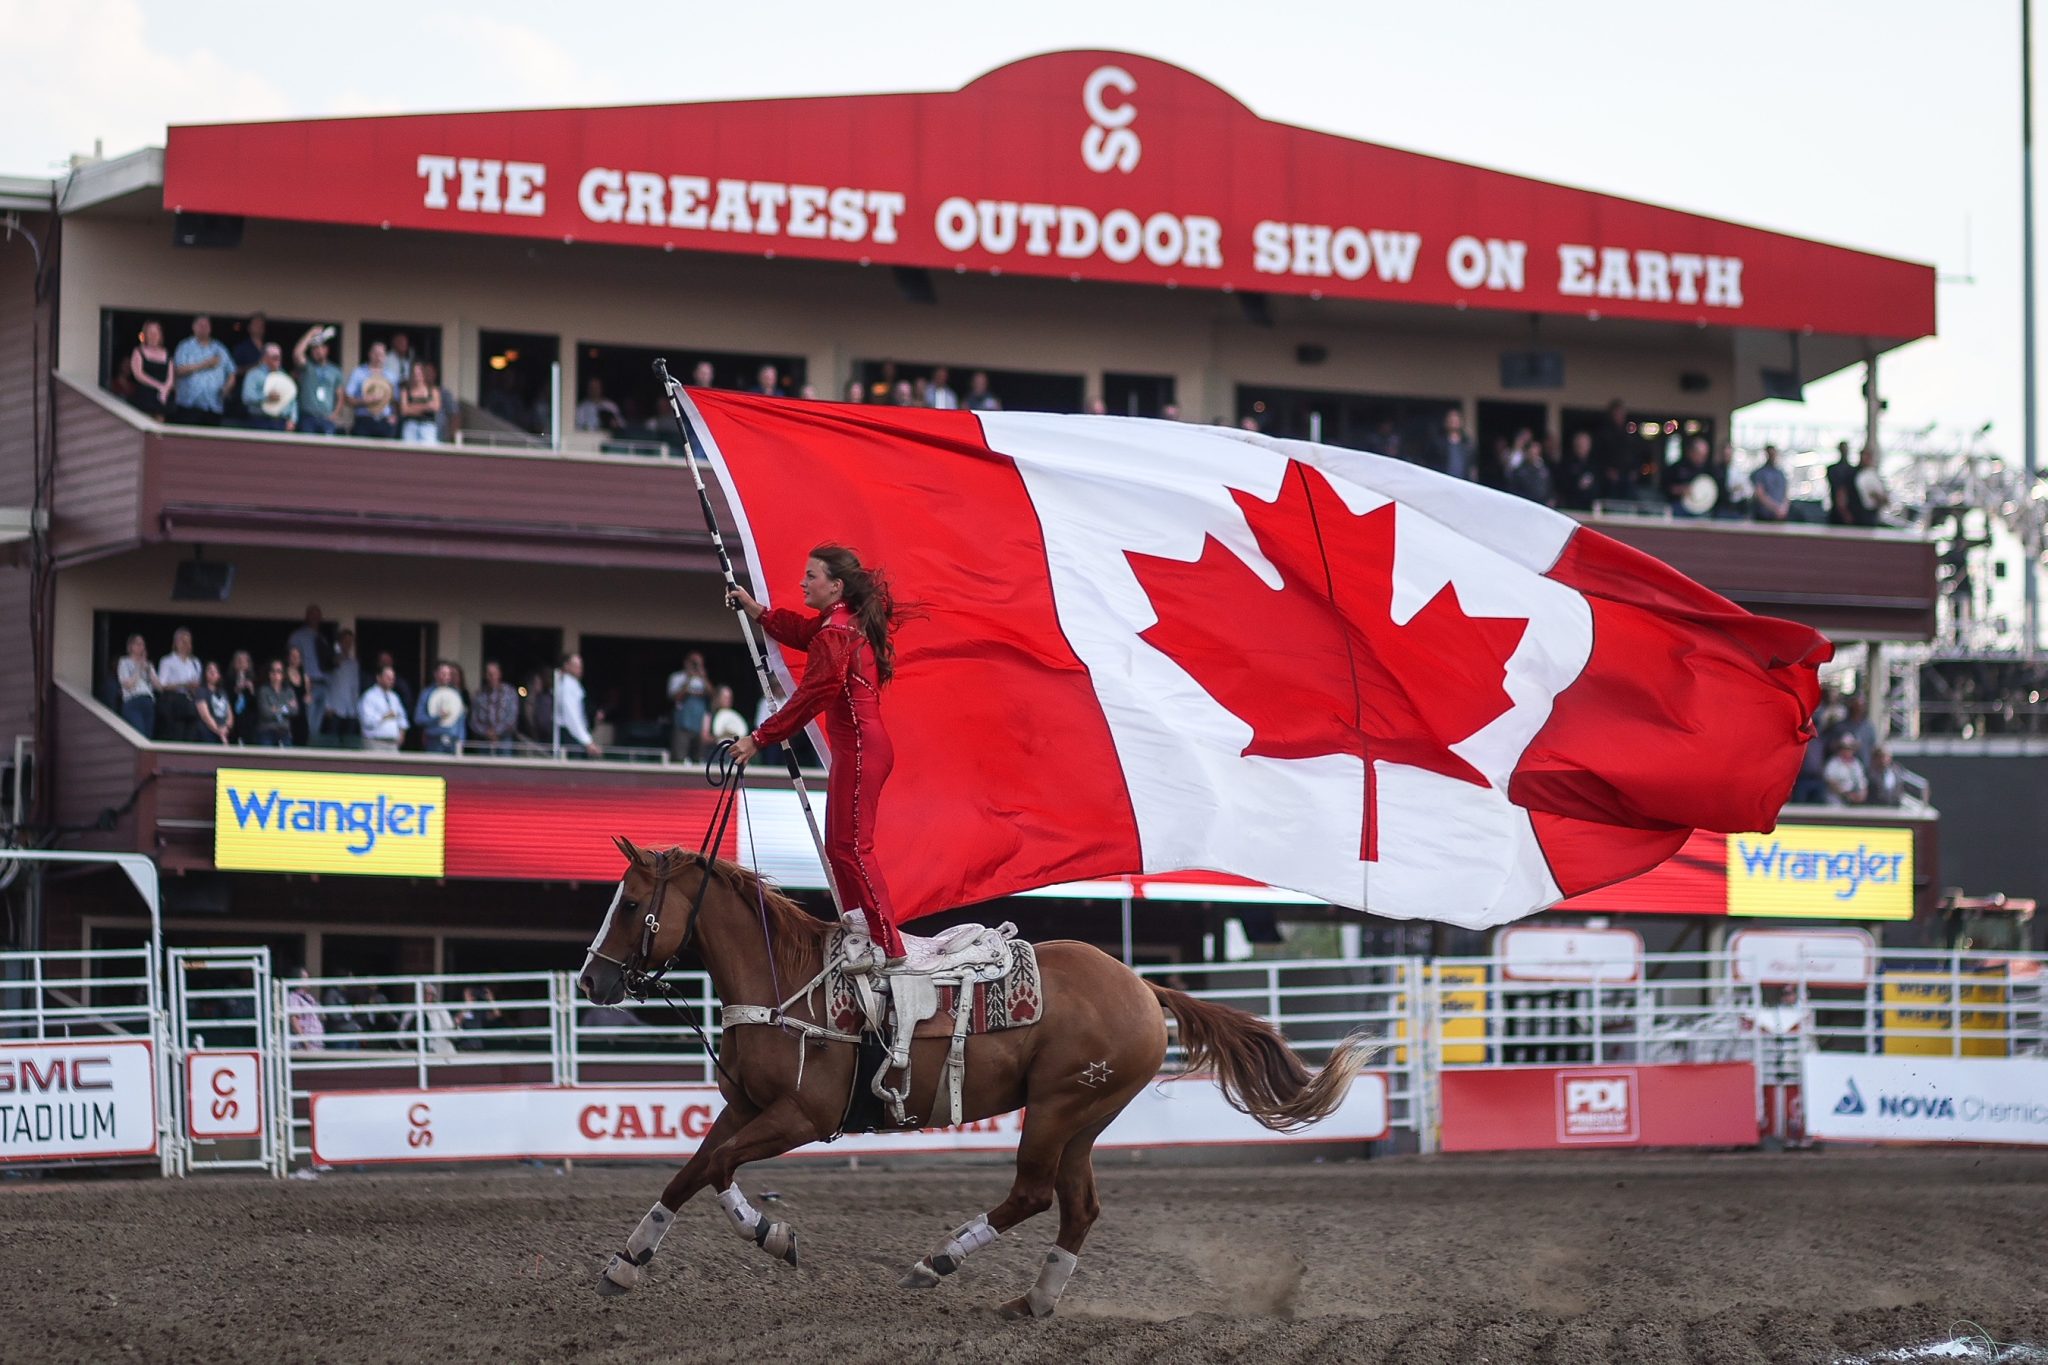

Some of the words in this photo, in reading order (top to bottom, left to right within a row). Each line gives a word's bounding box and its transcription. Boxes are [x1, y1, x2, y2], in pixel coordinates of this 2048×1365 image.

[417, 154, 546, 217] THE
[578, 167, 905, 243] GREATEST
[935, 197, 1224, 269] OUTDOOR
[1253, 219, 1422, 283] SHOW
[1447, 235, 1528, 292] ON
[1557, 243, 1744, 307] EARTH
[227, 787, 435, 855] Wrangler
[1738, 840, 1904, 901] Wrangler
[1567, 1080, 1627, 1113] PDI
[1880, 1095, 1954, 1119] NOVA
